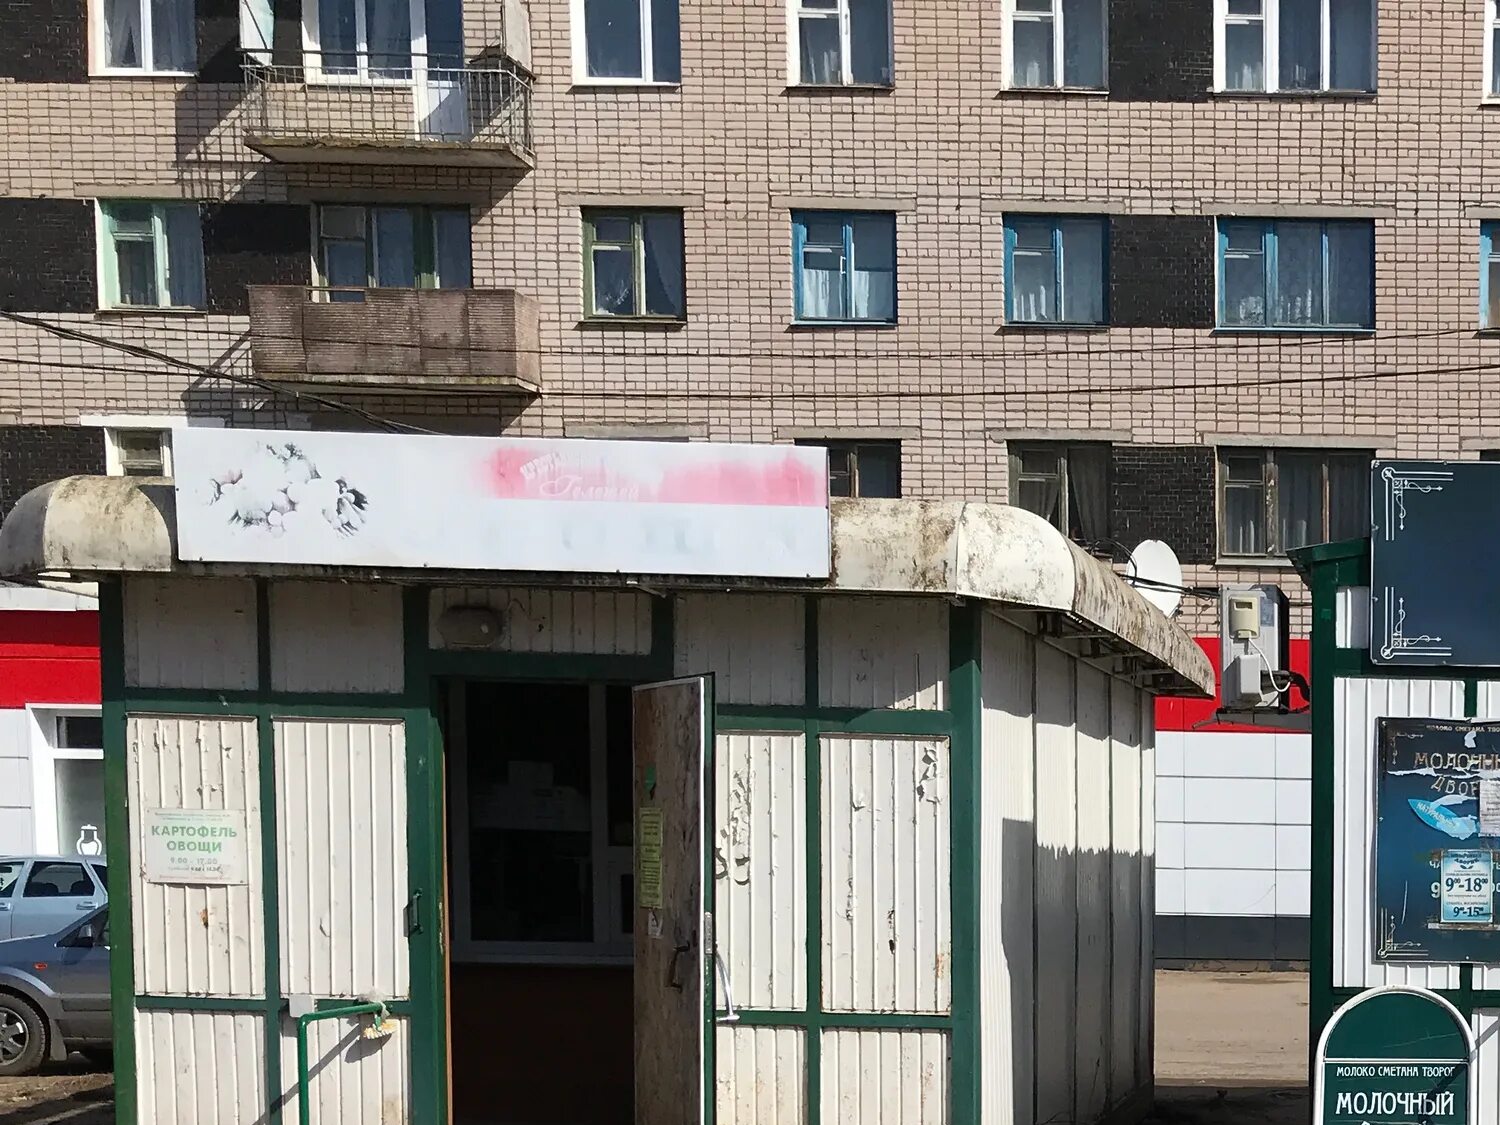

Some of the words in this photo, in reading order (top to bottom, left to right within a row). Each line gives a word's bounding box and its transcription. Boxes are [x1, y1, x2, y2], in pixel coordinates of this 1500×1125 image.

[151, 825, 238, 838] КАРТОФЕЛЬ
[166, 840, 222, 854] ОВОЩИ
[1336, 1067, 1375, 1077] МОЛОКО
[1378, 1067, 1419, 1077] СМЕТАНА
[1422, 1067, 1455, 1077] ТВОРОГ
[1335, 1091, 1455, 1116] МОЛОЧНЫЙ
